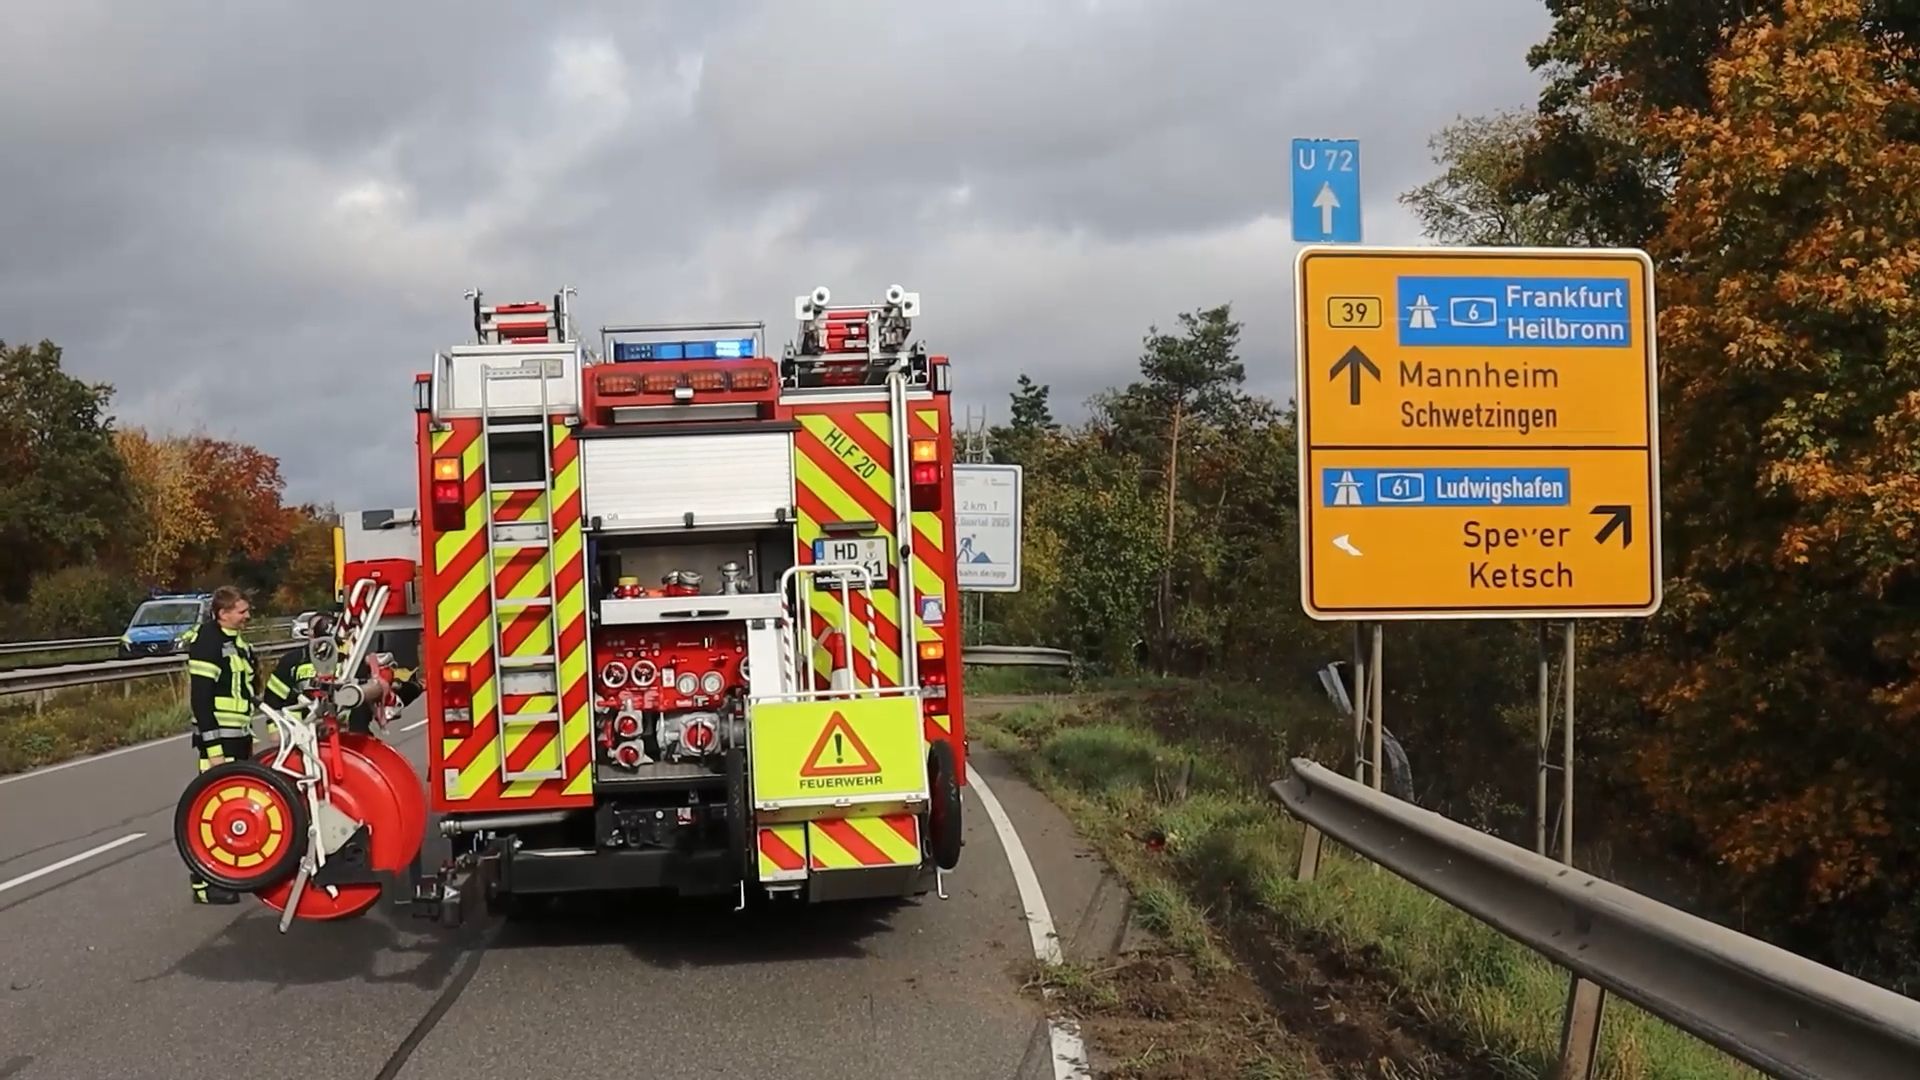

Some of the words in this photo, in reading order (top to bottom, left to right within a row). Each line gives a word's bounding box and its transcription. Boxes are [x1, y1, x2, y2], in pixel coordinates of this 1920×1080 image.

[1299, 148, 1316, 170] U
[1325, 149, 1353, 171] 72
[1506, 285, 1624, 308] Frankfurt
[1341, 302, 1368, 322] 39
[1468, 303, 1479, 321] 6
[1507, 317, 1625, 340] Heilbronn
[1399, 360, 1559, 387] Mannheim
[1400, 400, 1558, 435] Schwetzingen
[824, 427, 860, 458] HLF
[853, 455, 877, 479] 20
[1392, 478, 1411, 496] 61
[1436, 476, 1563, 504] Ludwigshafen
[834, 542, 858, 560] HD
[1469, 561, 1573, 589] Ketsch
[799, 775, 884, 789] FEUERWEHR
